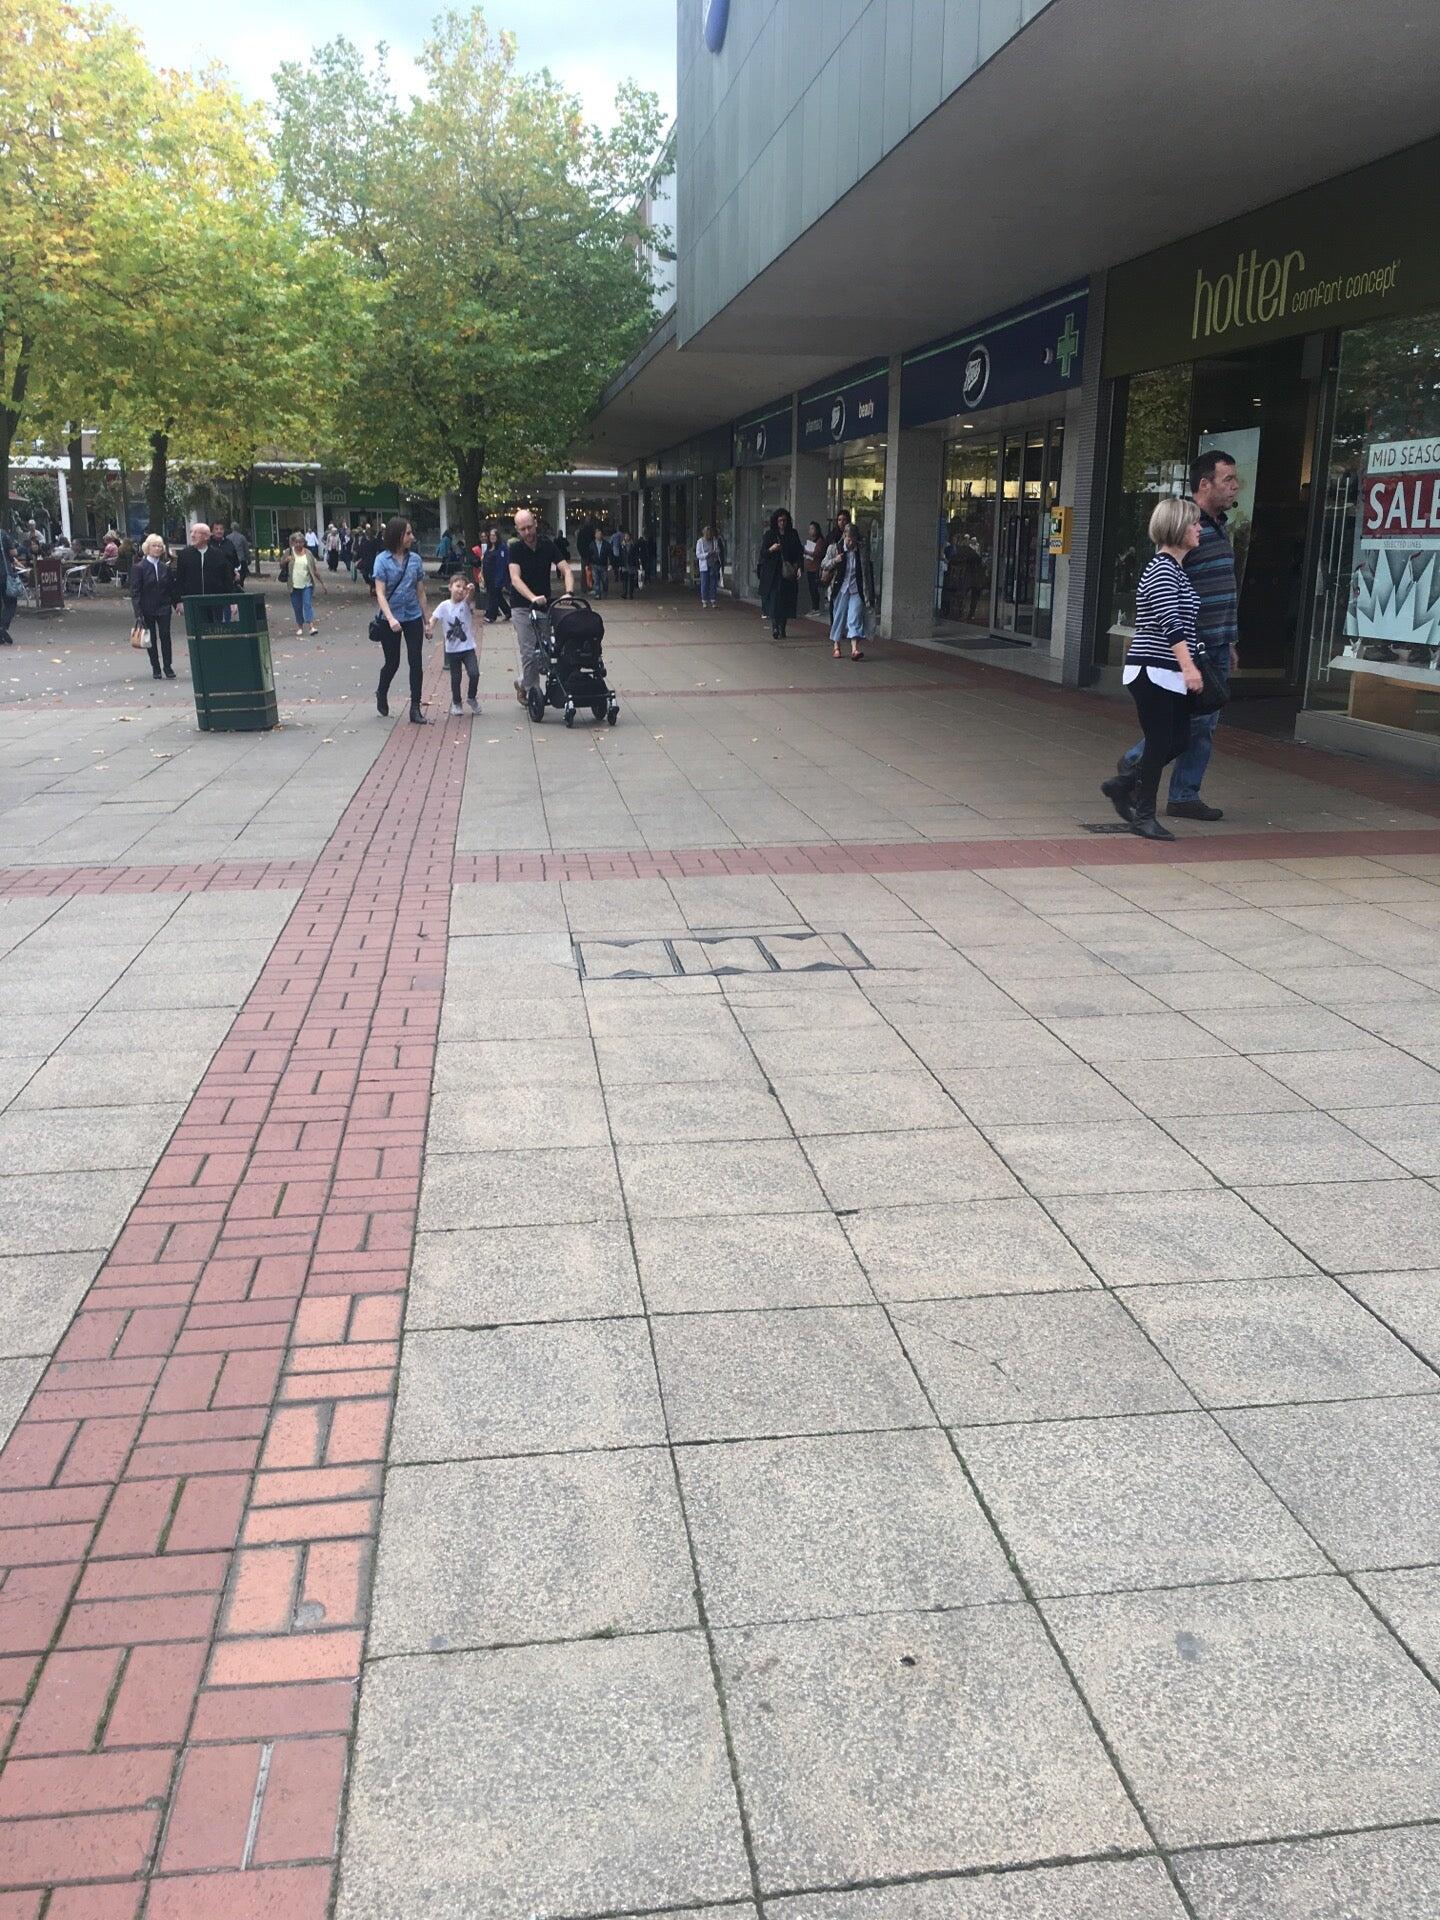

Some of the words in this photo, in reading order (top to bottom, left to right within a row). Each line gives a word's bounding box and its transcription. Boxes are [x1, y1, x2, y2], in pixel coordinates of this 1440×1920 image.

[1191, 249, 1306, 340] hotter
[1291, 276, 1343, 313] comfort
[1345, 260, 1397, 298] concept
[858, 398, 874, 419] beauty
[1372, 448, 1397, 467] MID
[1366, 480, 1440, 530] SALE
